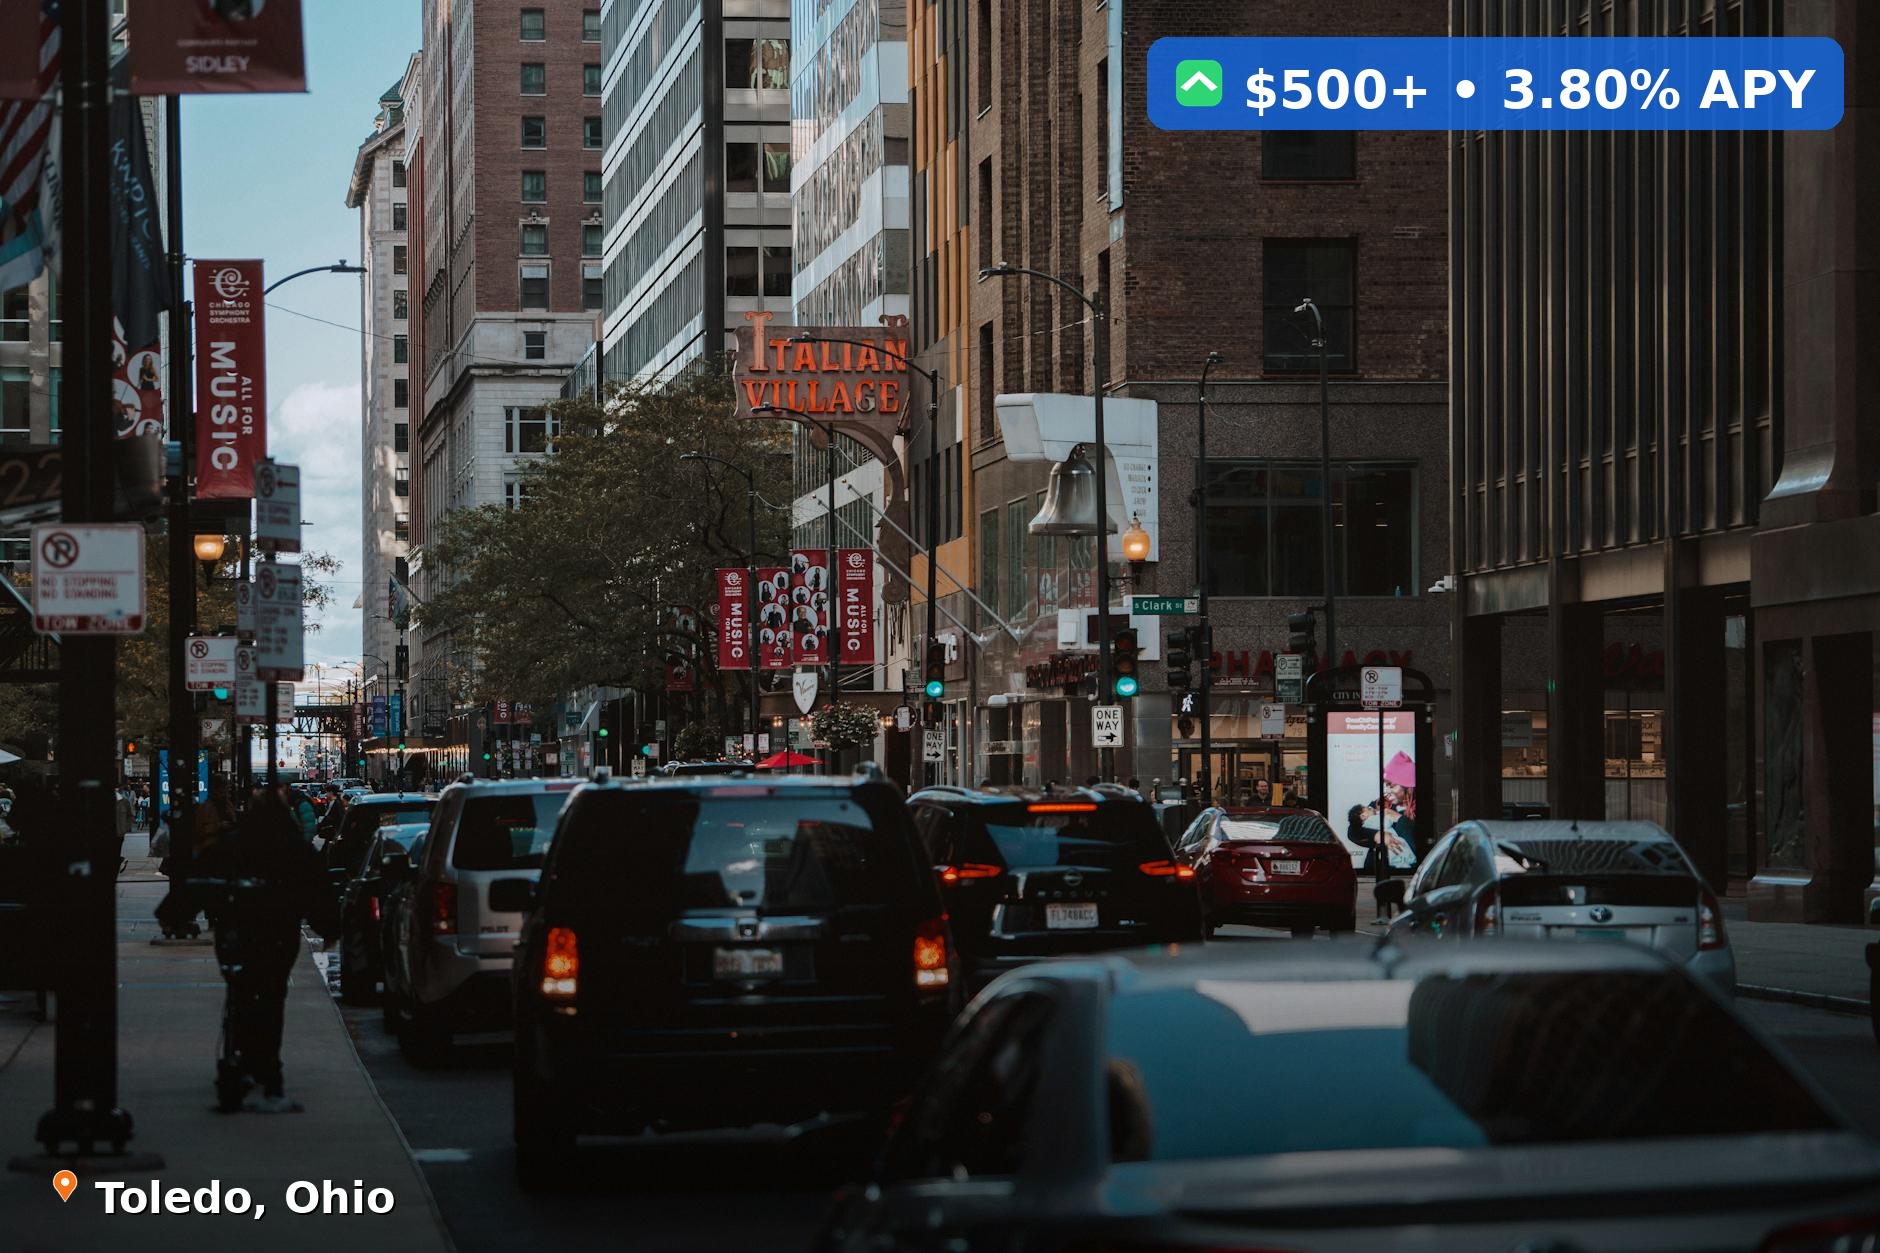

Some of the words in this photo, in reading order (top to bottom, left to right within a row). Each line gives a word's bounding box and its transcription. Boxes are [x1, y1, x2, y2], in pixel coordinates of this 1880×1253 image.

[185, 55, 250, 72] SIDLEY
[744, 311, 908, 373] ITALIAN
[241, 376, 253, 401] ALL
[741, 379, 900, 414] VILLAGE
[210, 341, 238, 470] MUSIC
[241, 406, 253, 435] FOR
[1142, 601, 1173, 611] Clark
[731, 602, 743, 658] MUSIC
[846, 588, 861, 651] MUSIC
[1332, 691, 1351, 700] CITY
[1096, 710, 1119, 719] ONE
[1096, 721, 1119, 730] WAY
[926, 741, 943, 749] WAY
